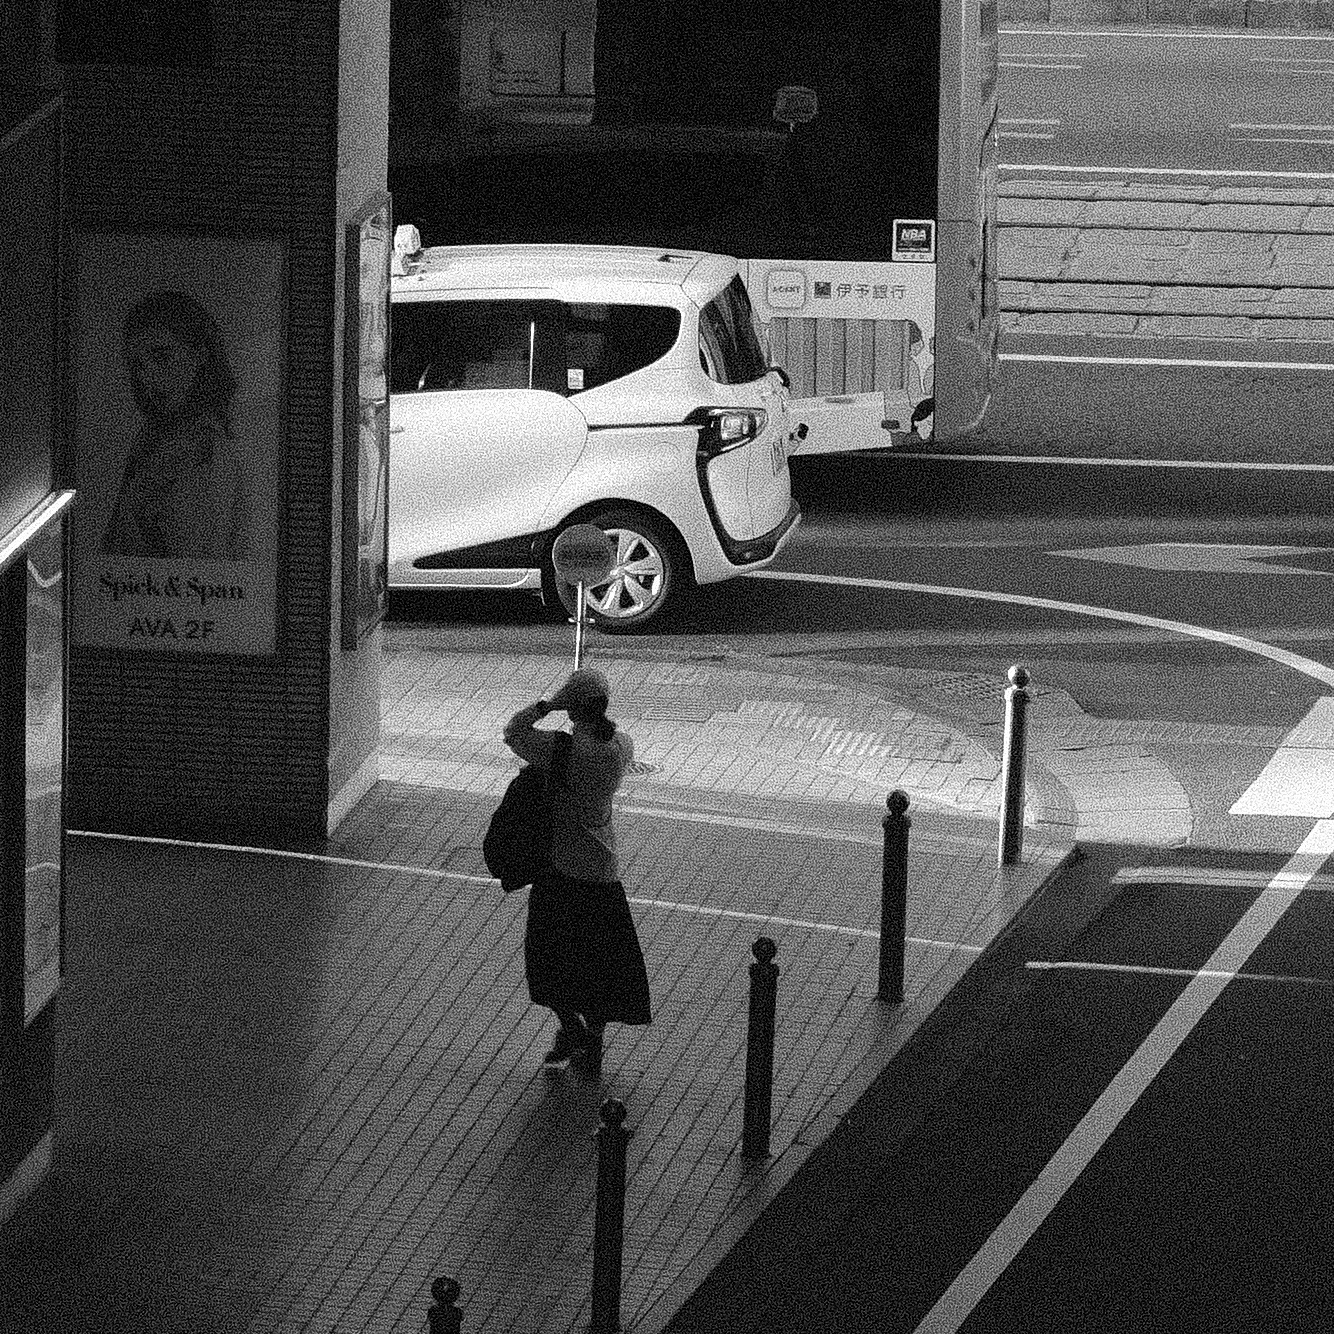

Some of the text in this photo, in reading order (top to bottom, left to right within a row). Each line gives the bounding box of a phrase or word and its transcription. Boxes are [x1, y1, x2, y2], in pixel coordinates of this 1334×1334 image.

[836, 283, 907, 301] 伊予銀行
[99, 571, 245, 605] Spick & Span
[128, 616, 216, 640] AVA 2F
